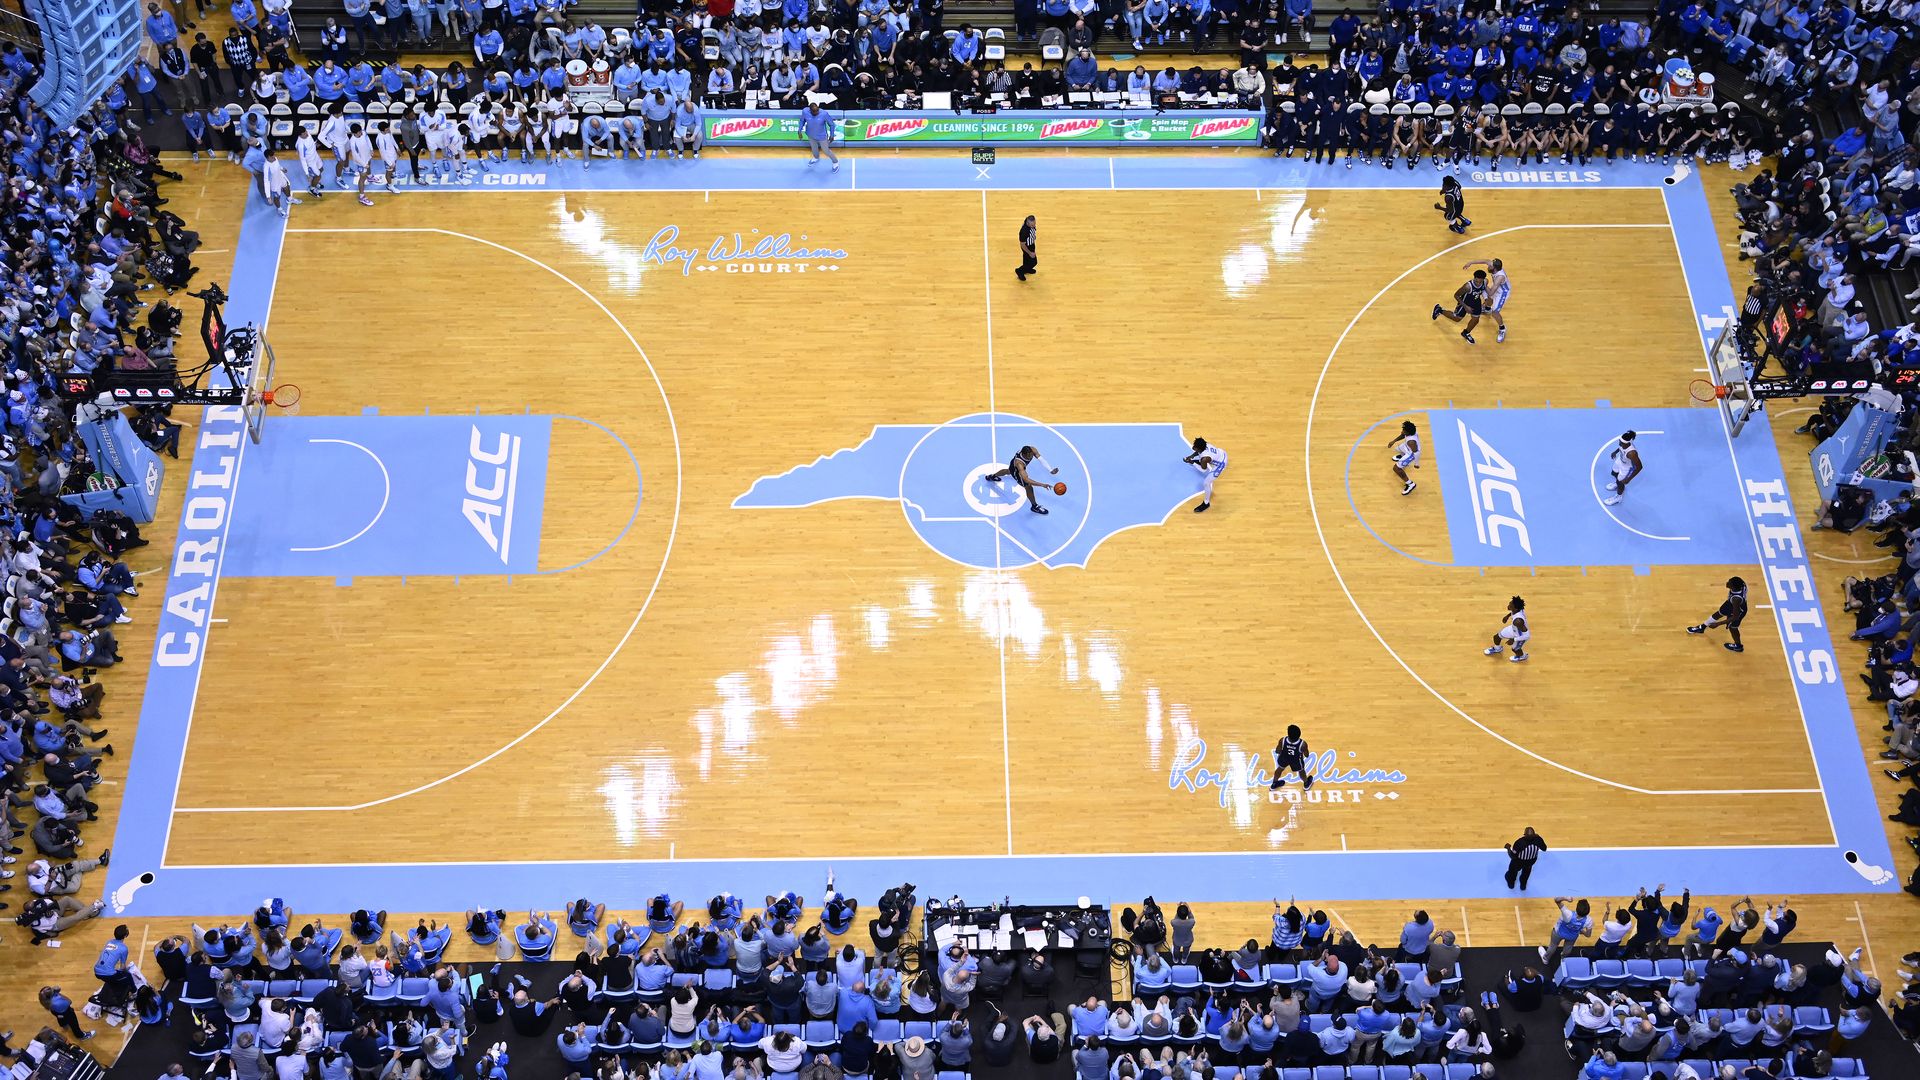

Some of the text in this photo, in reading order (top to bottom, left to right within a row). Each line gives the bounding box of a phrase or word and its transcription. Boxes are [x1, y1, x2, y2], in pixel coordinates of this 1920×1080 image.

[711, 118, 771, 139] LIBMAN
[865, 118, 926, 139] LIBMAN
[933, 123, 1035, 133] CLEANING SINCE 1896
[1040, 118, 1101, 140] LIBMAN
[1151, 119, 1189, 127] Spin Mop
[1190, 117, 1251, 139] LIBMAN
[1471, 171, 1602, 183] @GOHEELS
[641, 224, 848, 276] Roy Williams
[726, 263, 810, 273] COURT
[69, 383, 86, 393] 24
[461, 423, 511, 554] ACC
[1469, 428, 1533, 558] ACC
[1744, 478, 1837, 685] HEELS
[1168, 738, 1231, 808] Roy
[1268, 789, 1365, 804] COURT
[371, 967, 383, 977] 23
